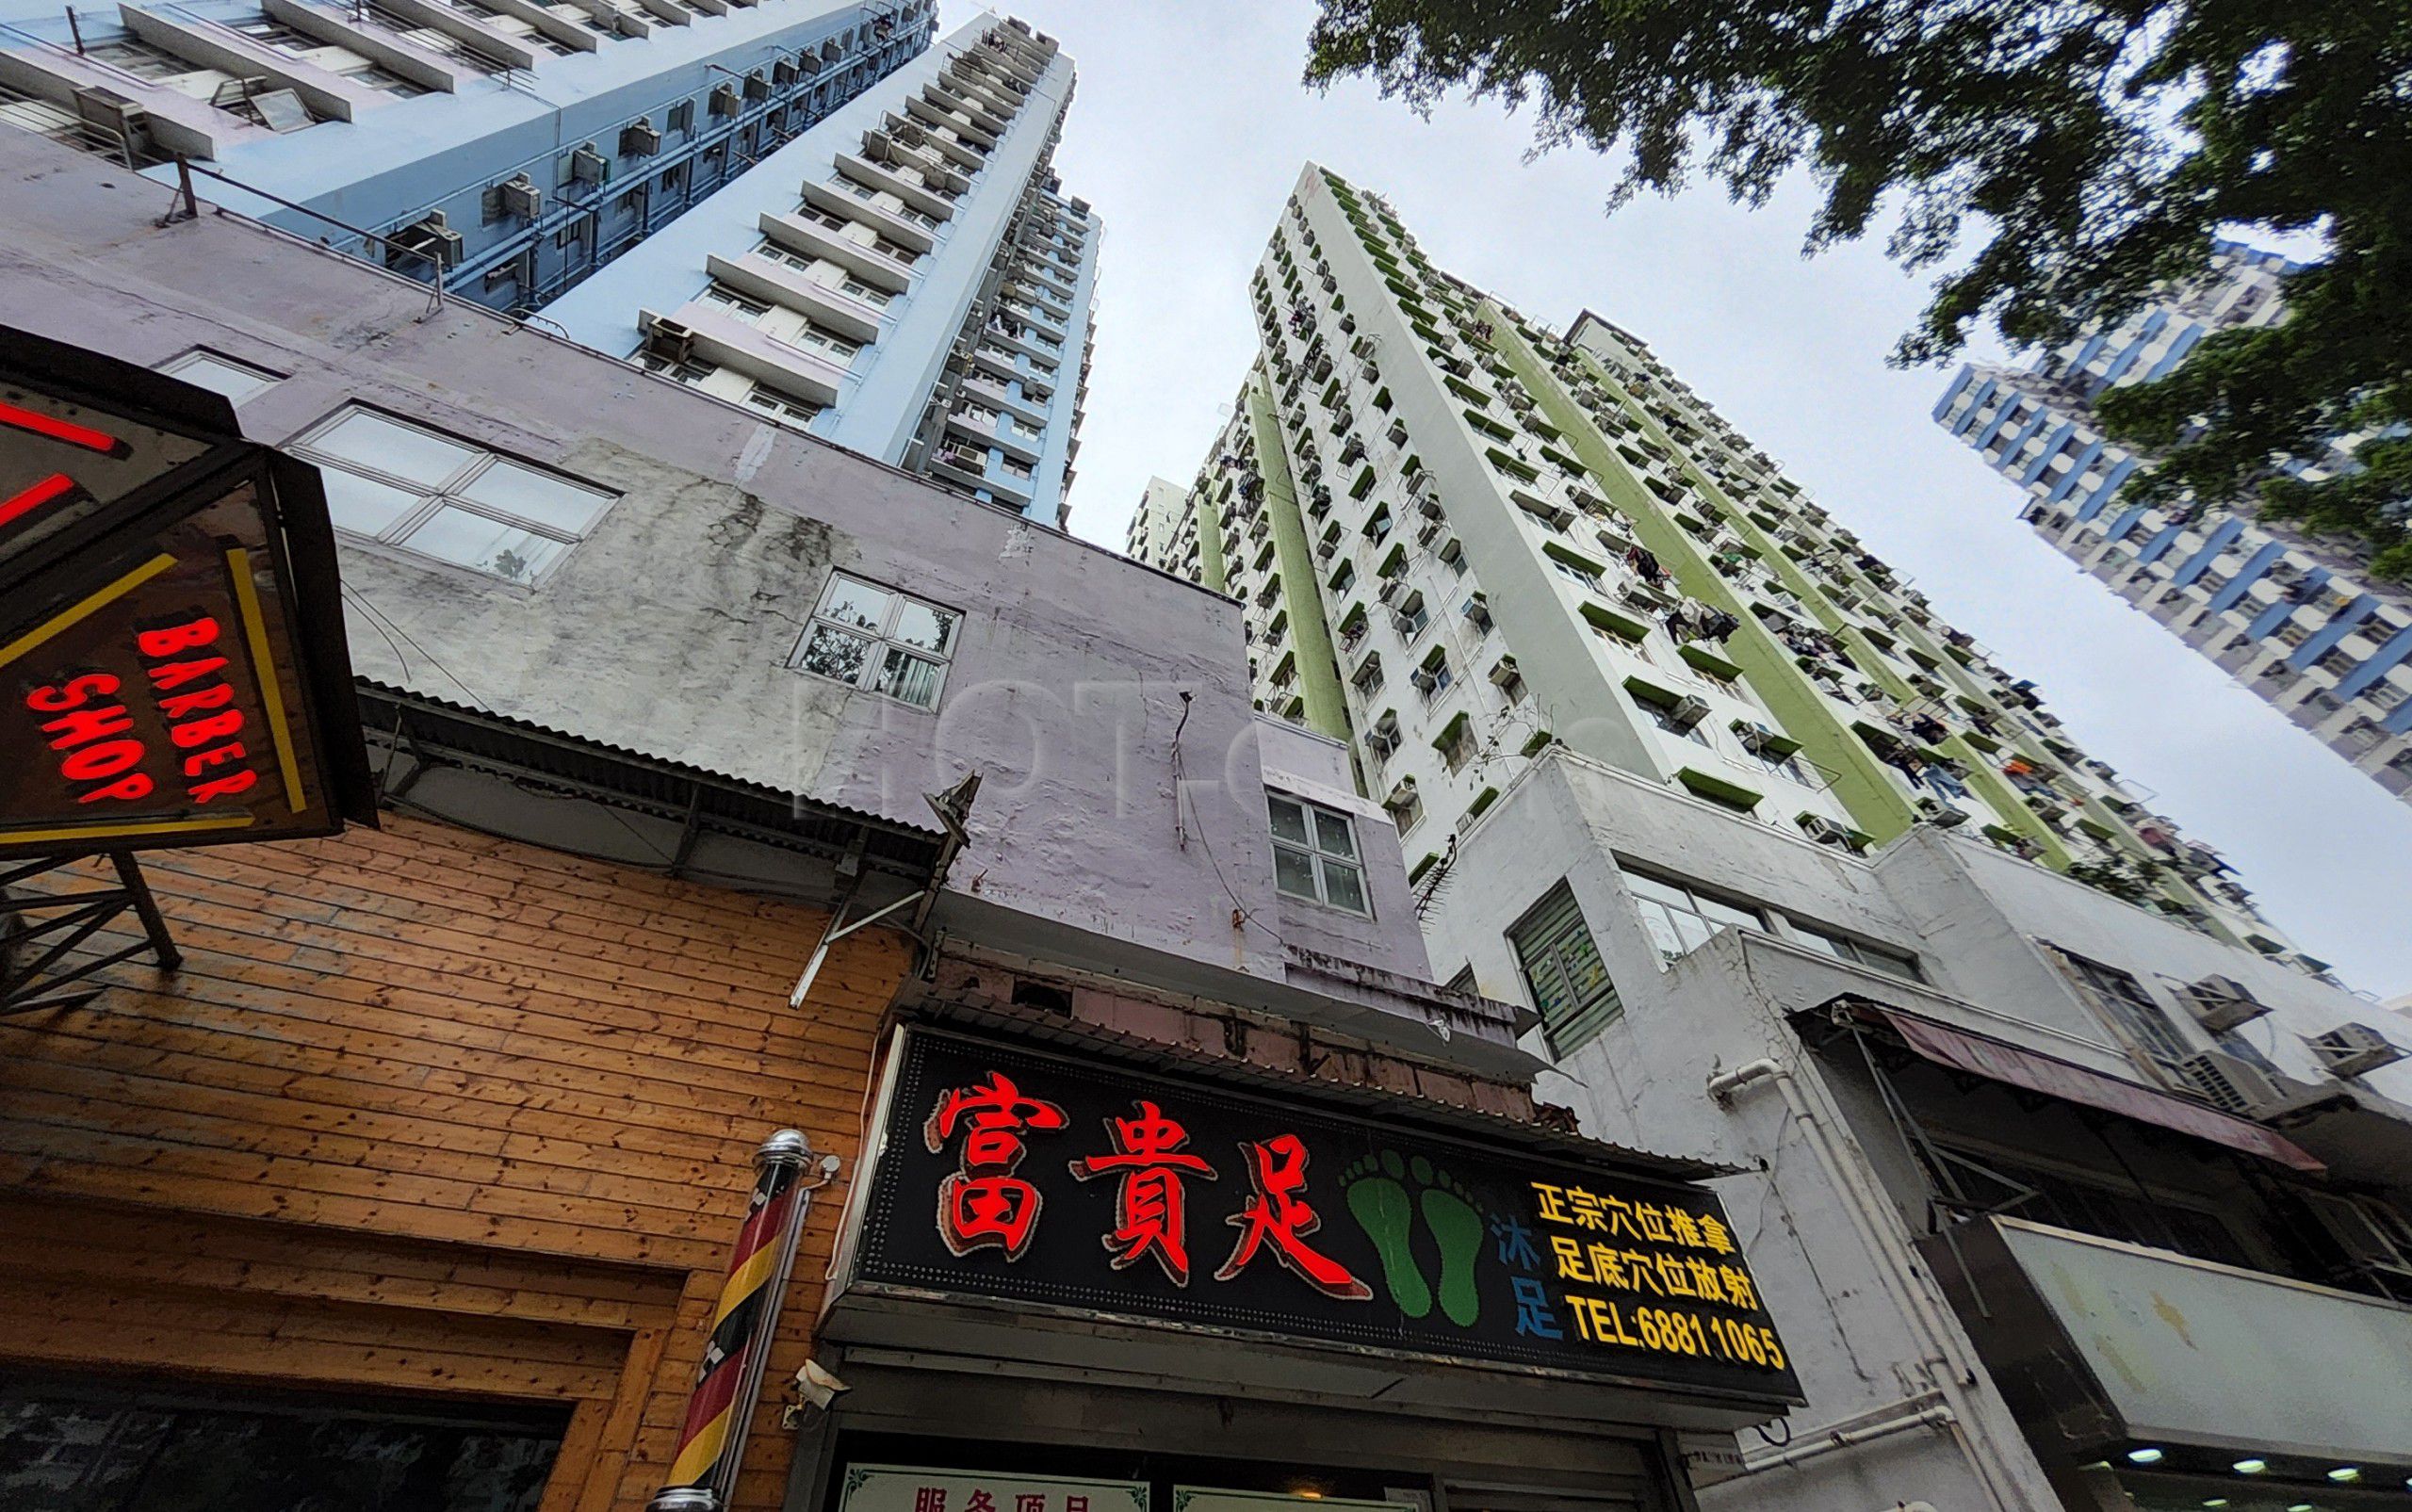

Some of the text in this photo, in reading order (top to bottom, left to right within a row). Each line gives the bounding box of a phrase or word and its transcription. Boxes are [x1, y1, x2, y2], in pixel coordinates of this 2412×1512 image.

[26, 673, 154, 805] SHOP
[138, 616, 257, 804] BARBER
[924, 1070, 1374, 1300] 富貴足
[1530, 1180, 1736, 1255] 正宗穴位推拿
[1489, 1211, 1564, 1341] 沐足
[1550, 1234, 1759, 1311] 足底穴位放射
